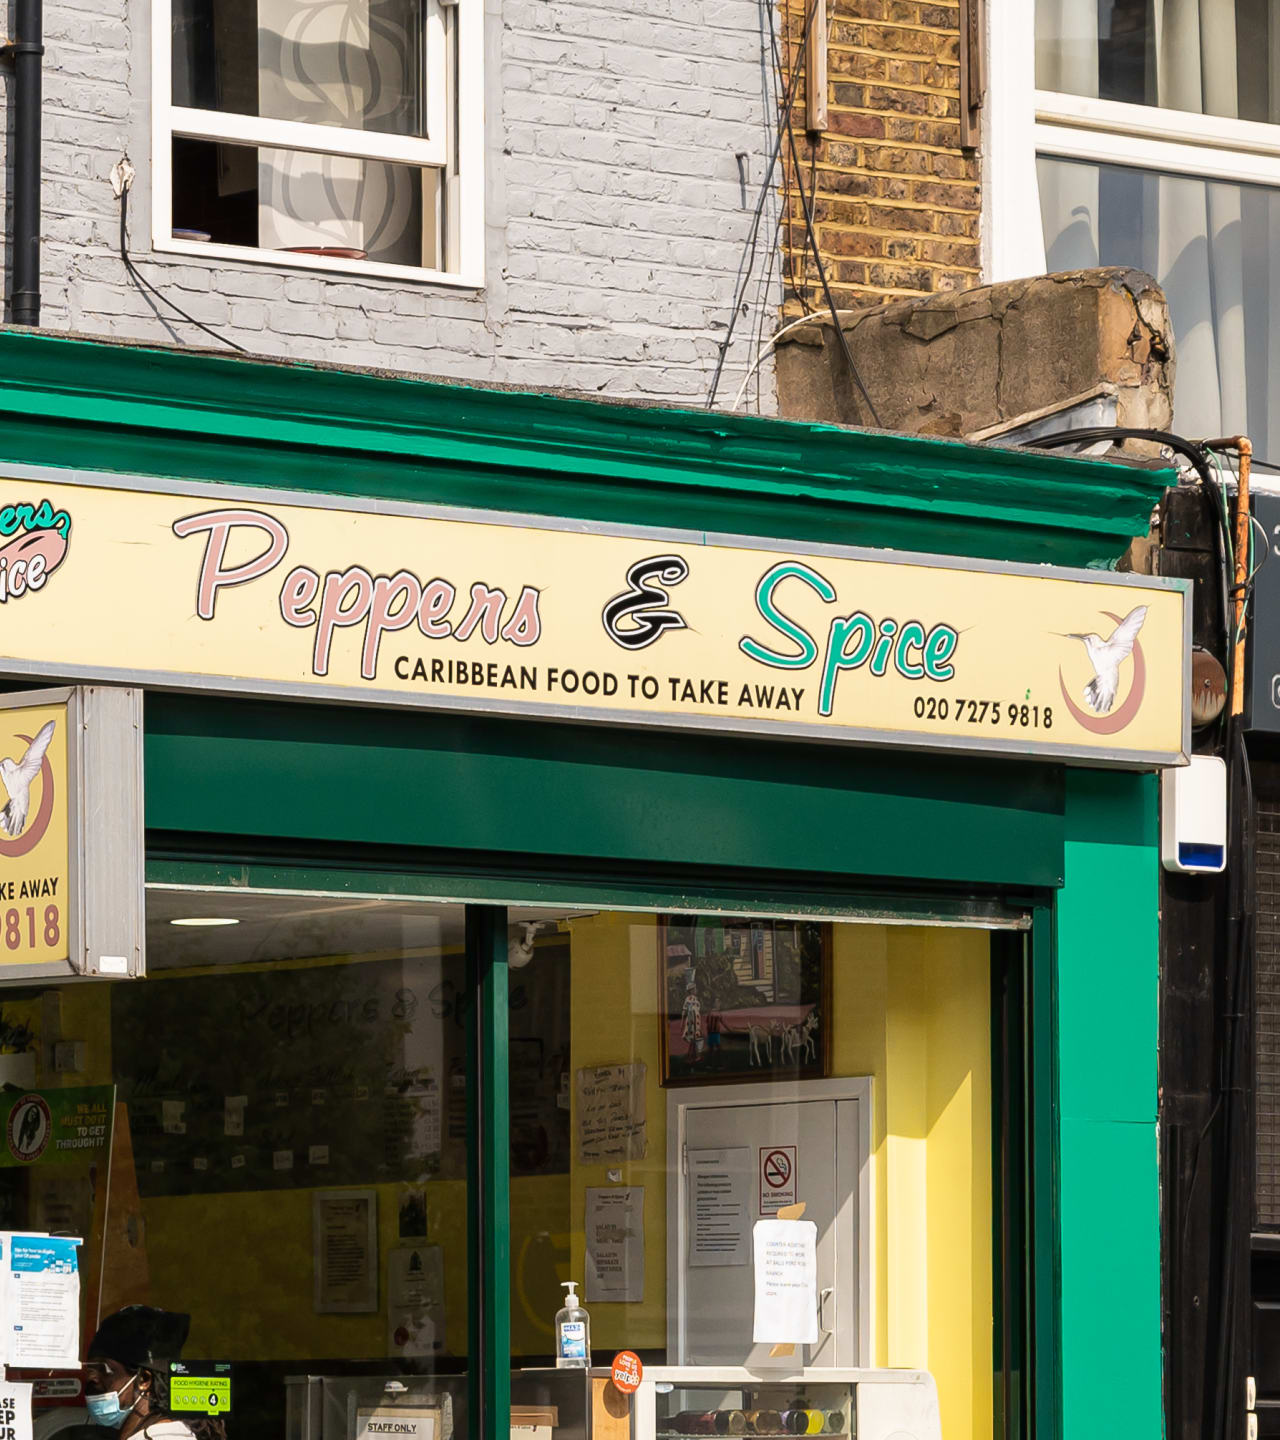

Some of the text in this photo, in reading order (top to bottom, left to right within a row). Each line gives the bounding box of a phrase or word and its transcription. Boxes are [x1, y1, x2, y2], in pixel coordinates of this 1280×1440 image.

[172, 508, 957, 717] Peppers & Spice
[393, 655, 806, 712] CARIBBEAN FOOD TO TAKE AWAY
[912, 696, 1053, 730] 020 7275 9818
[19, 876, 59, 899] AWAY
[209, 1394, 217, 1405] 4
[368, 1423, 417, 1432] STAFF ONLY
